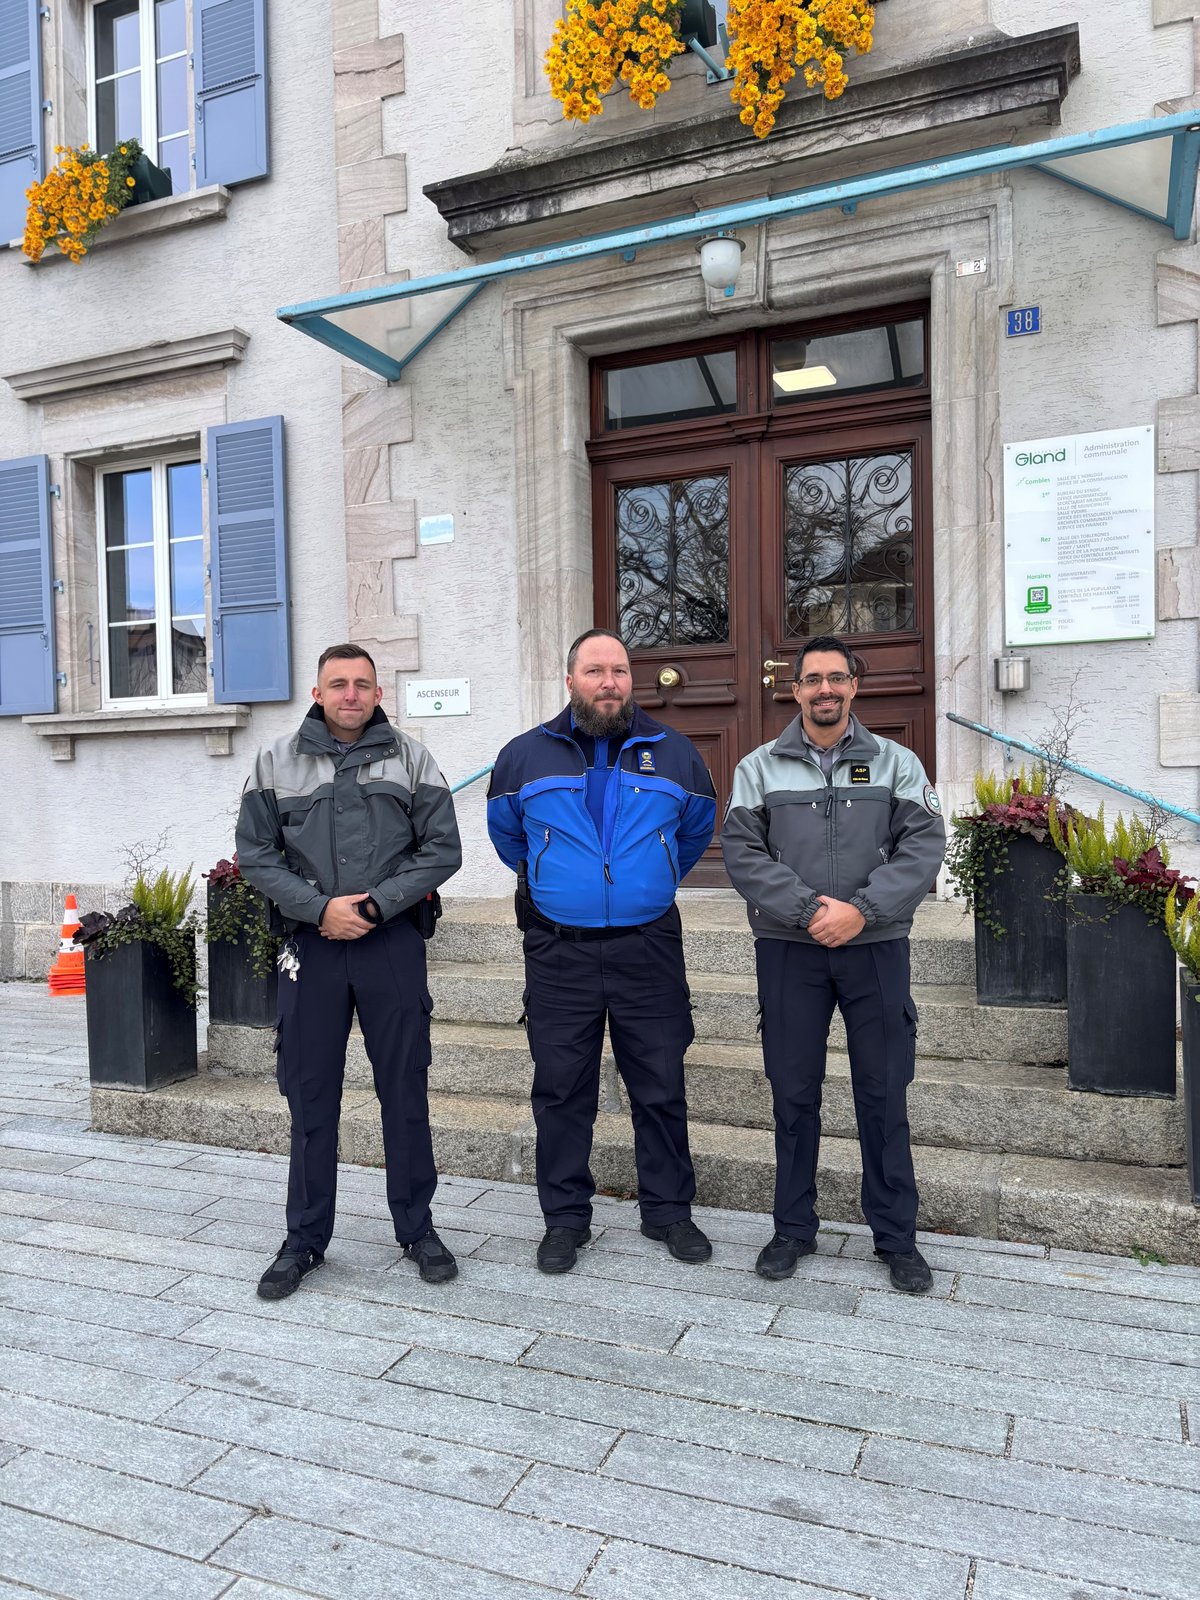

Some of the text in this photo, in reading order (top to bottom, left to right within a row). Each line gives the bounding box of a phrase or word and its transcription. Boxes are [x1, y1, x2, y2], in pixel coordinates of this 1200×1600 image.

[974, 261, 980, 270] 2
[1014, 310, 1032, 332] 38
[1084, 440, 1139, 452] Administration
[1015, 448, 1066, 466] Gland
[1084, 448, 1128, 459] communale
[1025, 477, 1050, 485] Combles
[1086, 474, 1128, 483] COMMUNICATION
[416, 689, 460, 698] ASCENSEUR
